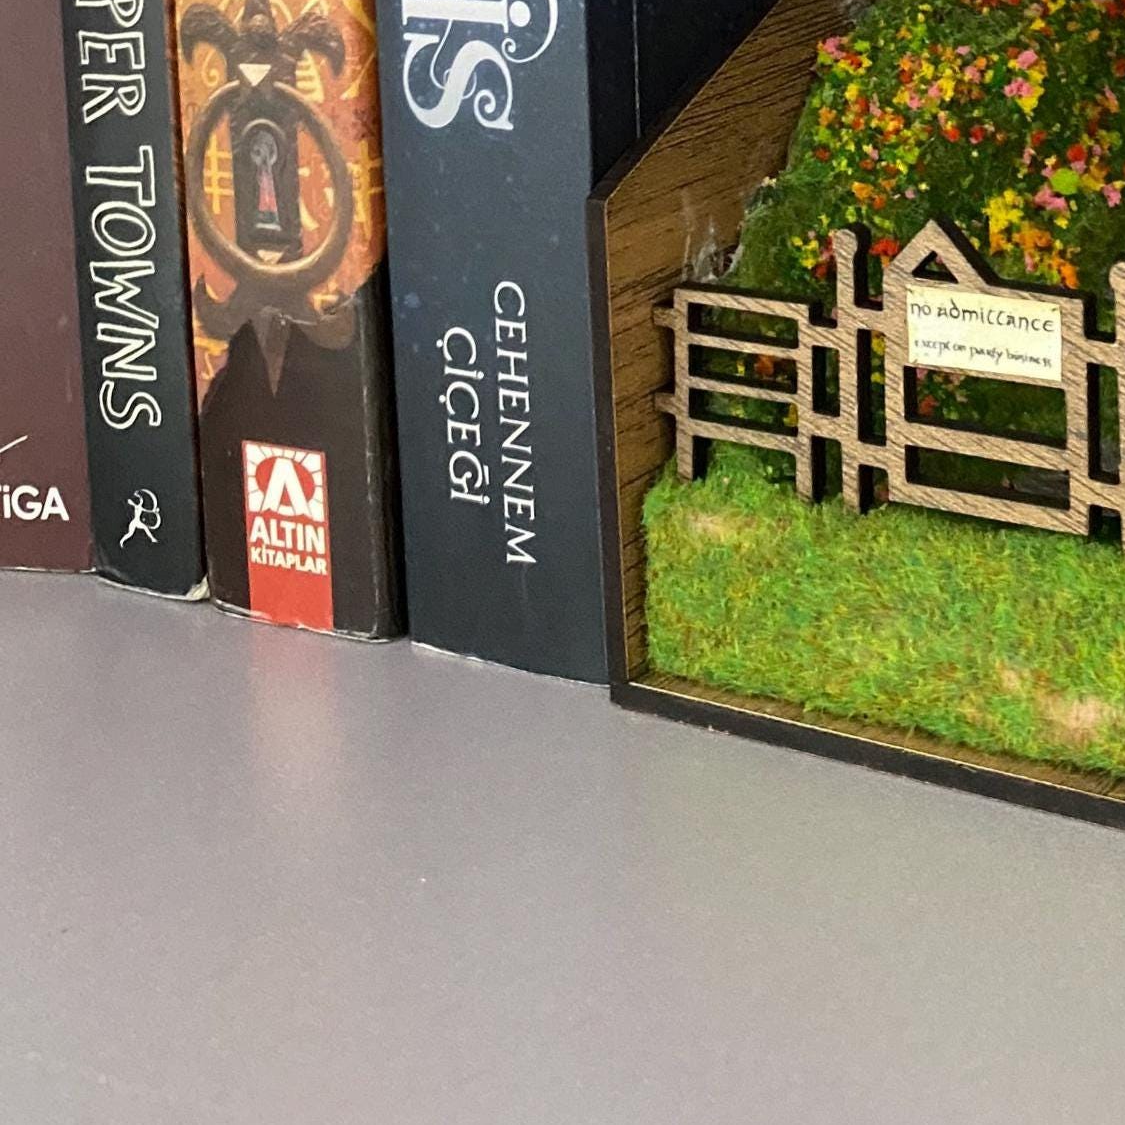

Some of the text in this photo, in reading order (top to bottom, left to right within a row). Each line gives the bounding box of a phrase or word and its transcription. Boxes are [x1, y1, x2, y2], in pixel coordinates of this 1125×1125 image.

[84, 143, 163, 430] TOWNS
[910, 302, 932, 317] no
[492, 280, 537, 564] CEHENNEM
[250, 516, 327, 555] ALTIN
